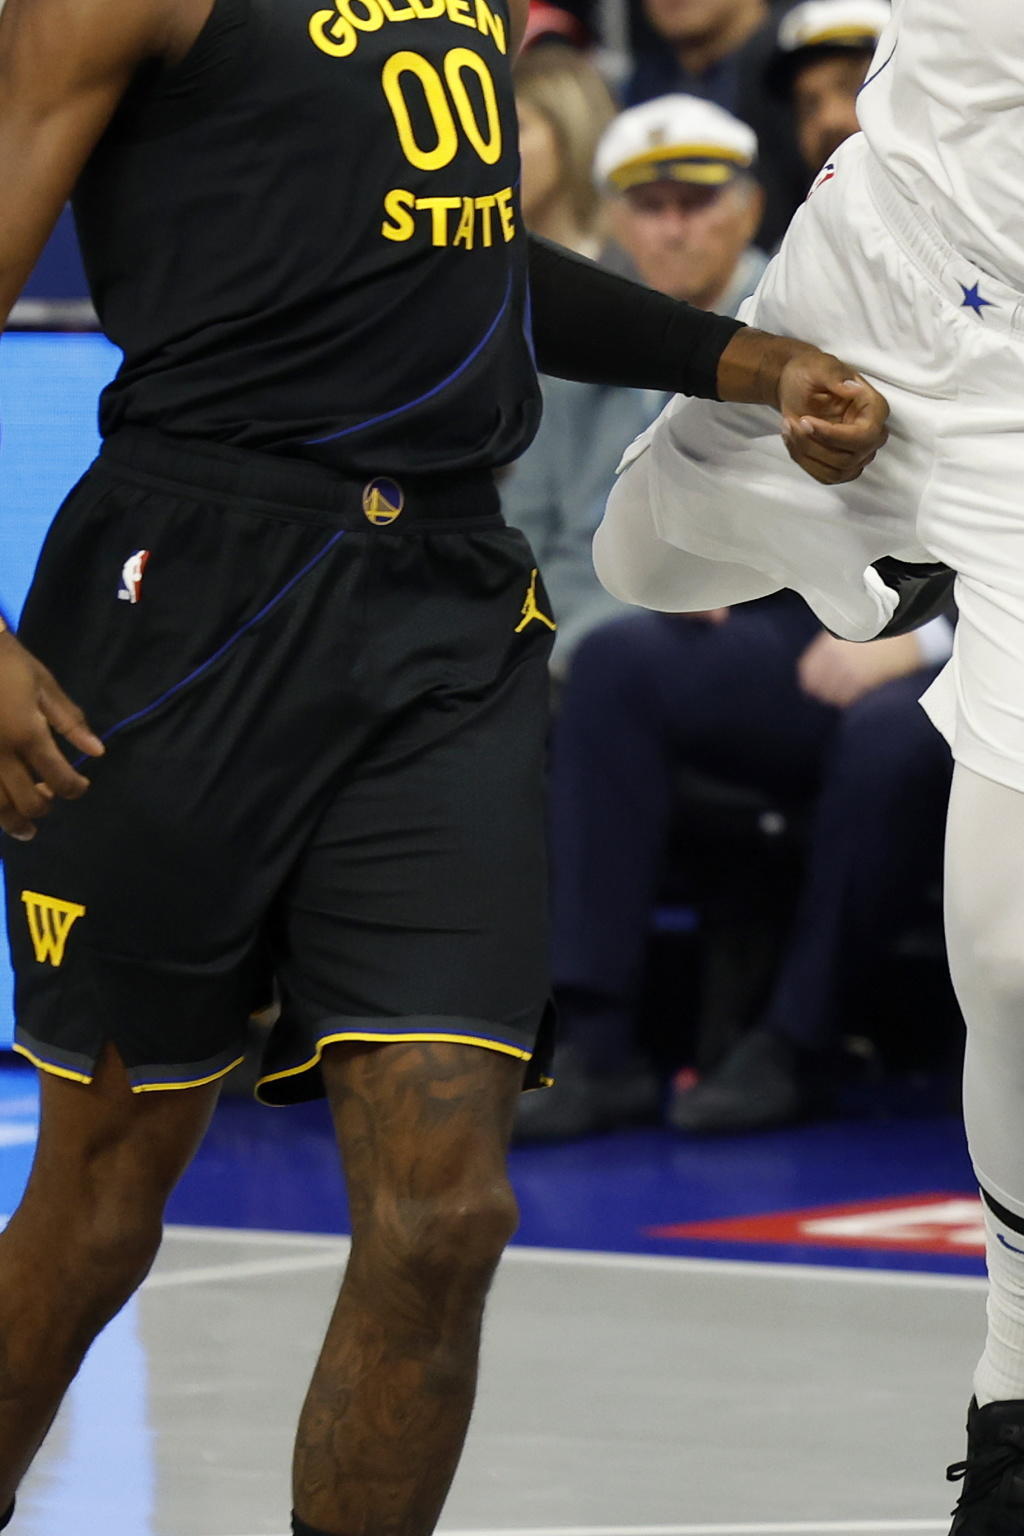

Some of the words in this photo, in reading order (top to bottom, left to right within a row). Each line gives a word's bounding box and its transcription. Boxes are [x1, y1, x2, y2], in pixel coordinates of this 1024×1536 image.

[381, 46, 502, 171] 00
[381, 186, 516, 251] STATE
[20, 889, 87, 967] W
